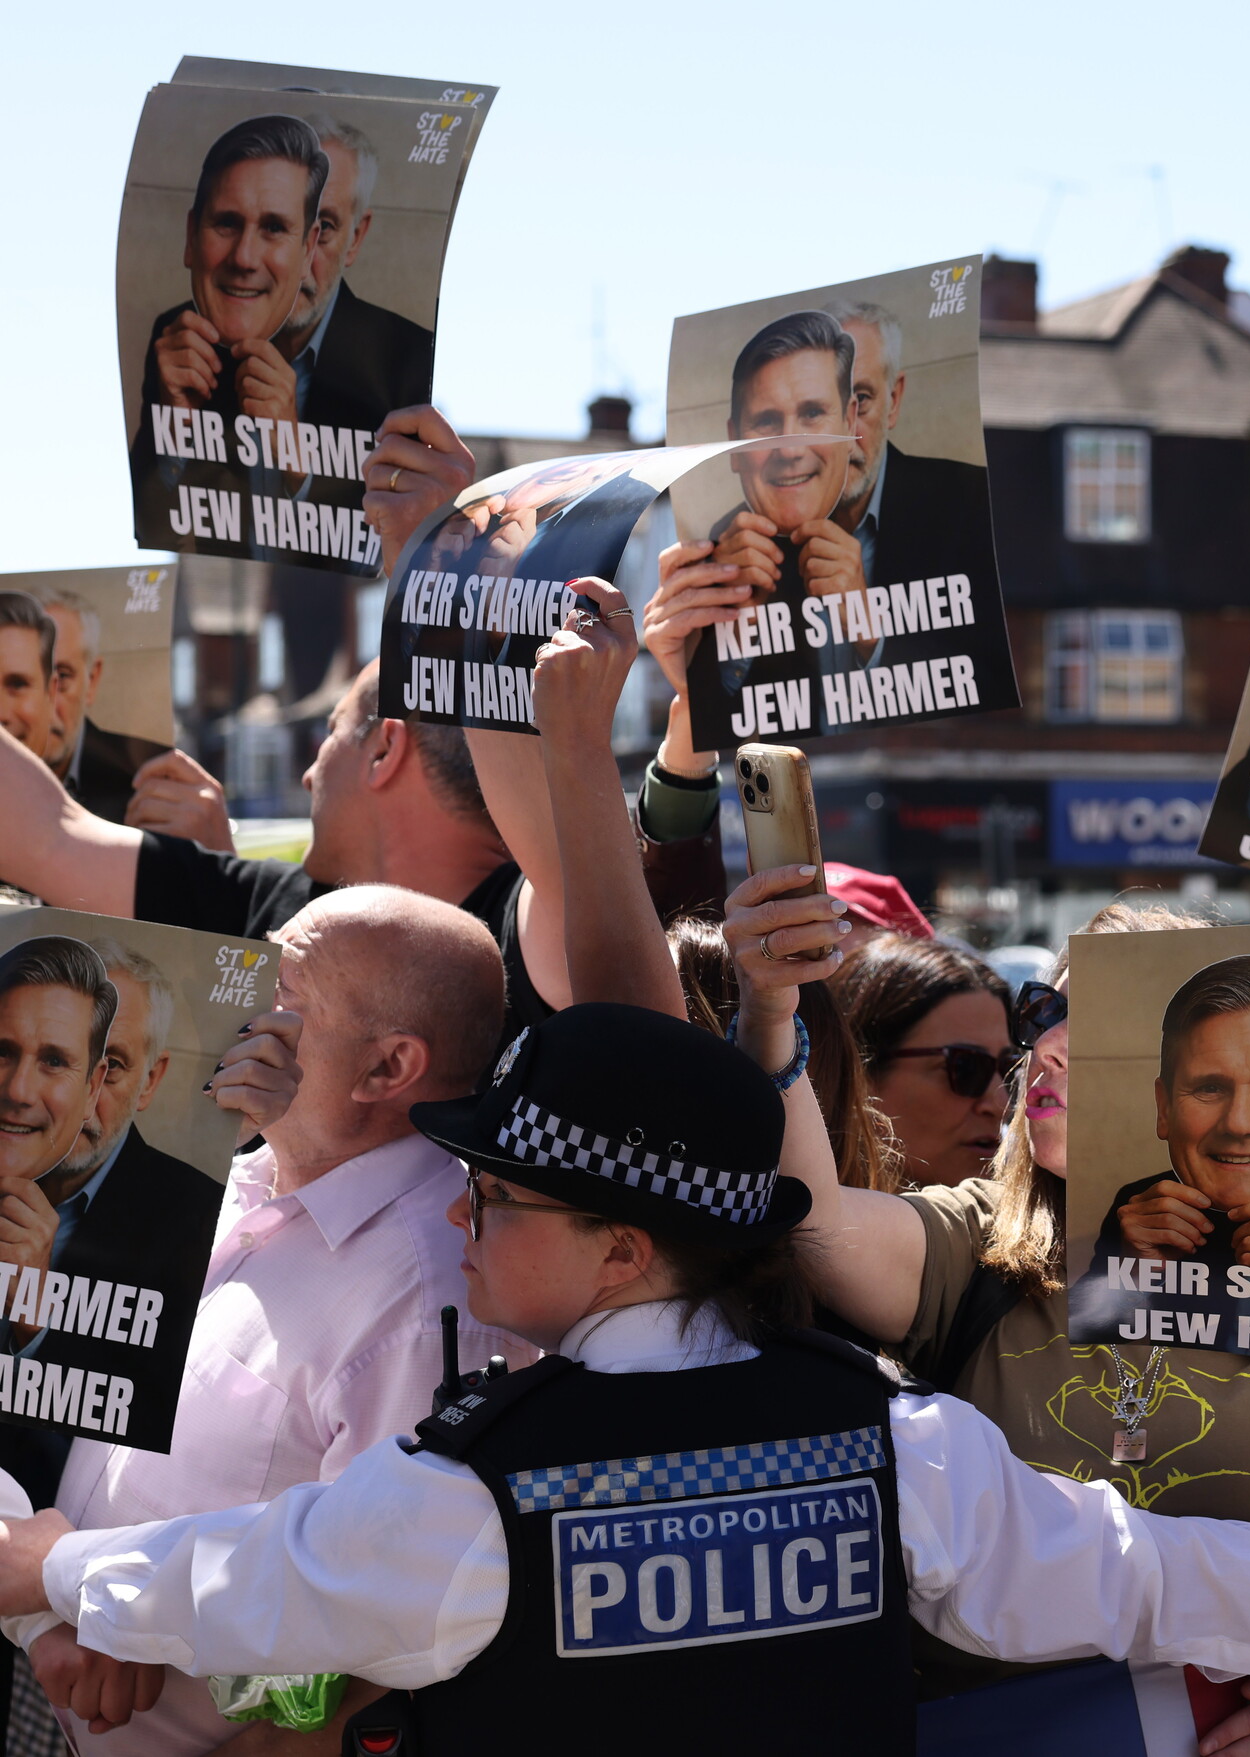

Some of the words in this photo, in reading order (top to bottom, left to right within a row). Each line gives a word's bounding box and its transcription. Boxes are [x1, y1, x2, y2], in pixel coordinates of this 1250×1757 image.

[408, 145, 449, 165] HATE
[420, 129, 452, 147] THE
[928, 296, 967, 319] HATE
[935, 281, 966, 301] THE
[151, 403, 227, 463] KEIR
[234, 414, 381, 482] STARME
[170, 485, 241, 542] JEW
[124, 598, 160, 614] HATE
[130, 585, 160, 600] THE
[401, 570, 458, 627] KEIR
[714, 601, 796, 662] KEIR
[801, 573, 975, 648] STARMER
[403, 655, 455, 715] JEW
[463, 661, 537, 723] HARM
[731, 678, 811, 738] JEW
[822, 654, 980, 726] HARMER
[1068, 797, 1211, 843] WOO
[209, 984, 257, 1008] HATE
[220, 967, 258, 988] THE
[1107, 1256, 1210, 1296] KEIR
[0, 1261, 164, 1348] TARMER
[1118, 1308, 1221, 1345] JEW
[0, 1353, 134, 1436] ARMER
[570, 1494, 870, 1552] METROPOLITAN
[571, 1530, 872, 1640] POLICE
